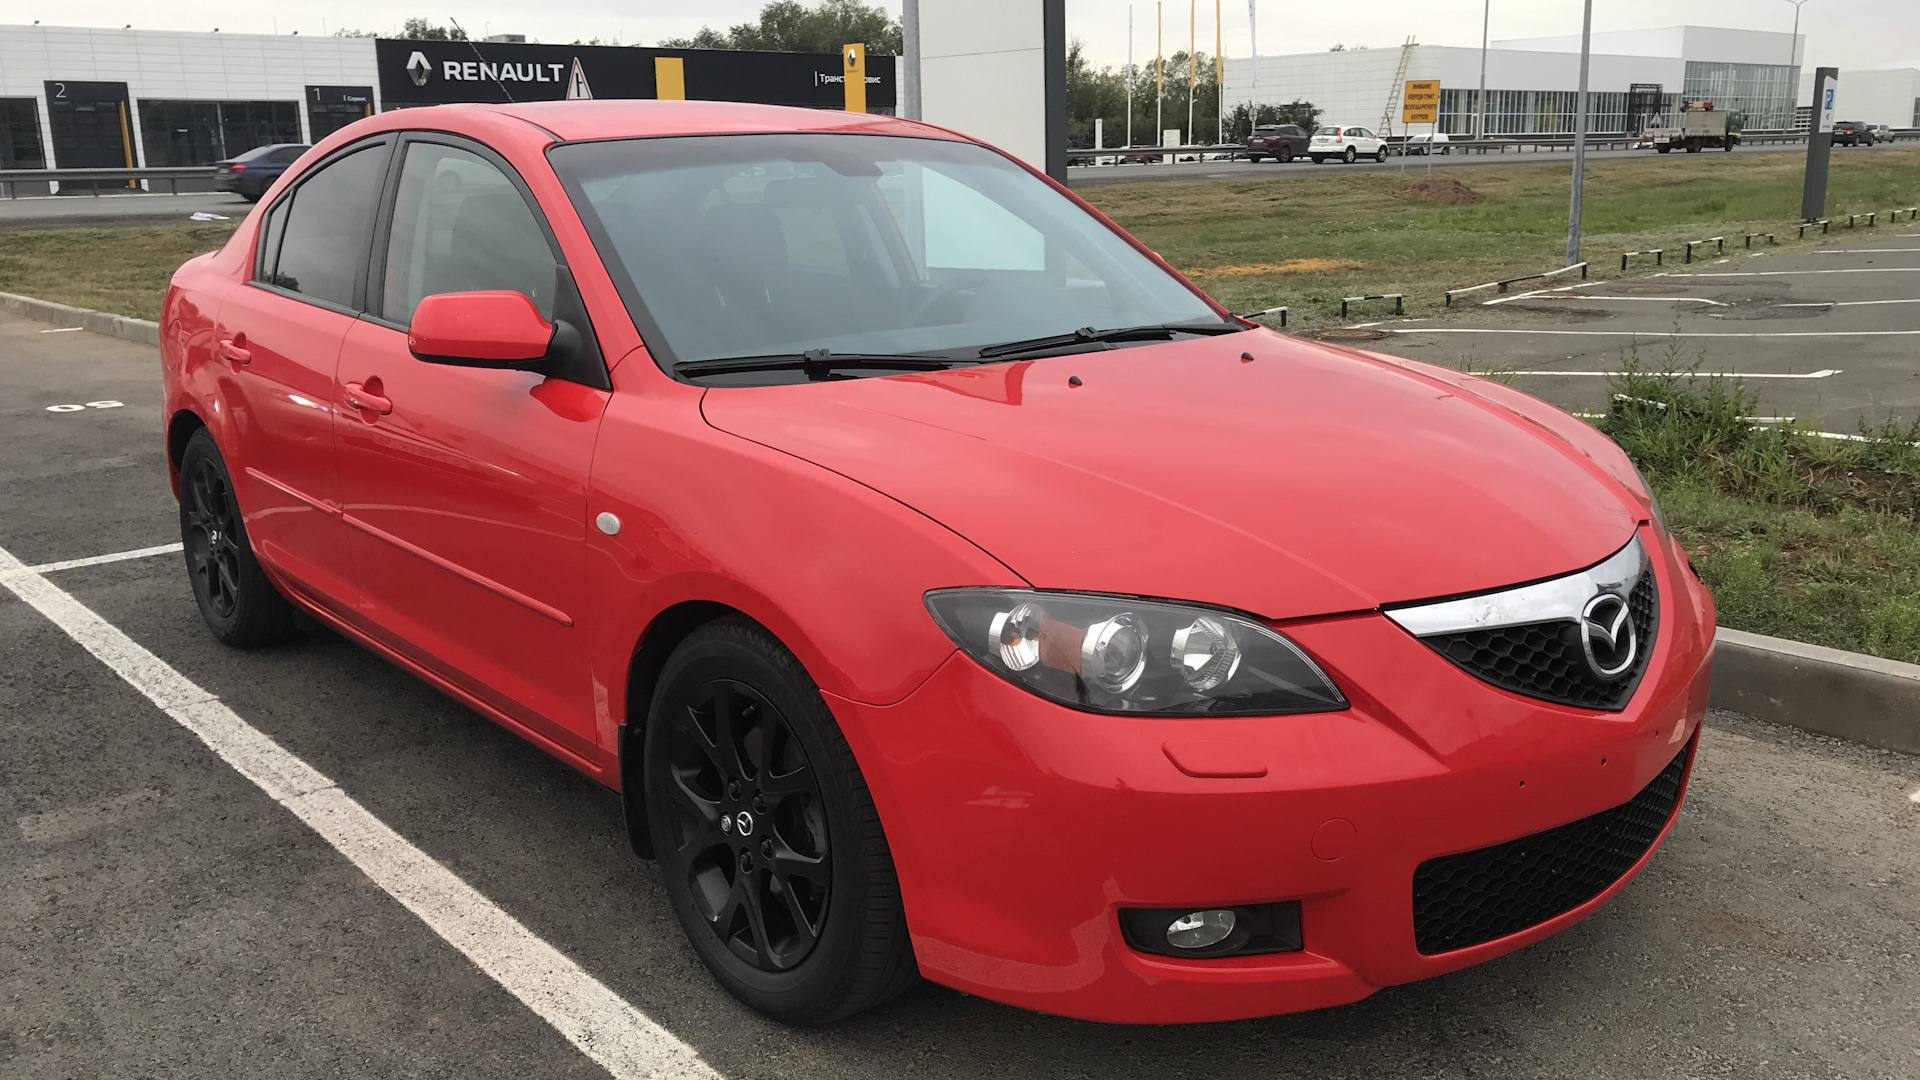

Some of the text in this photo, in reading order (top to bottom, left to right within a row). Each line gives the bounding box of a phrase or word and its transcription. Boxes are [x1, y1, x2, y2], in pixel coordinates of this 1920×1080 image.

[443, 61, 564, 82] RENAULT
[54, 82, 67, 98] 2
[313, 87, 320, 101] 1
